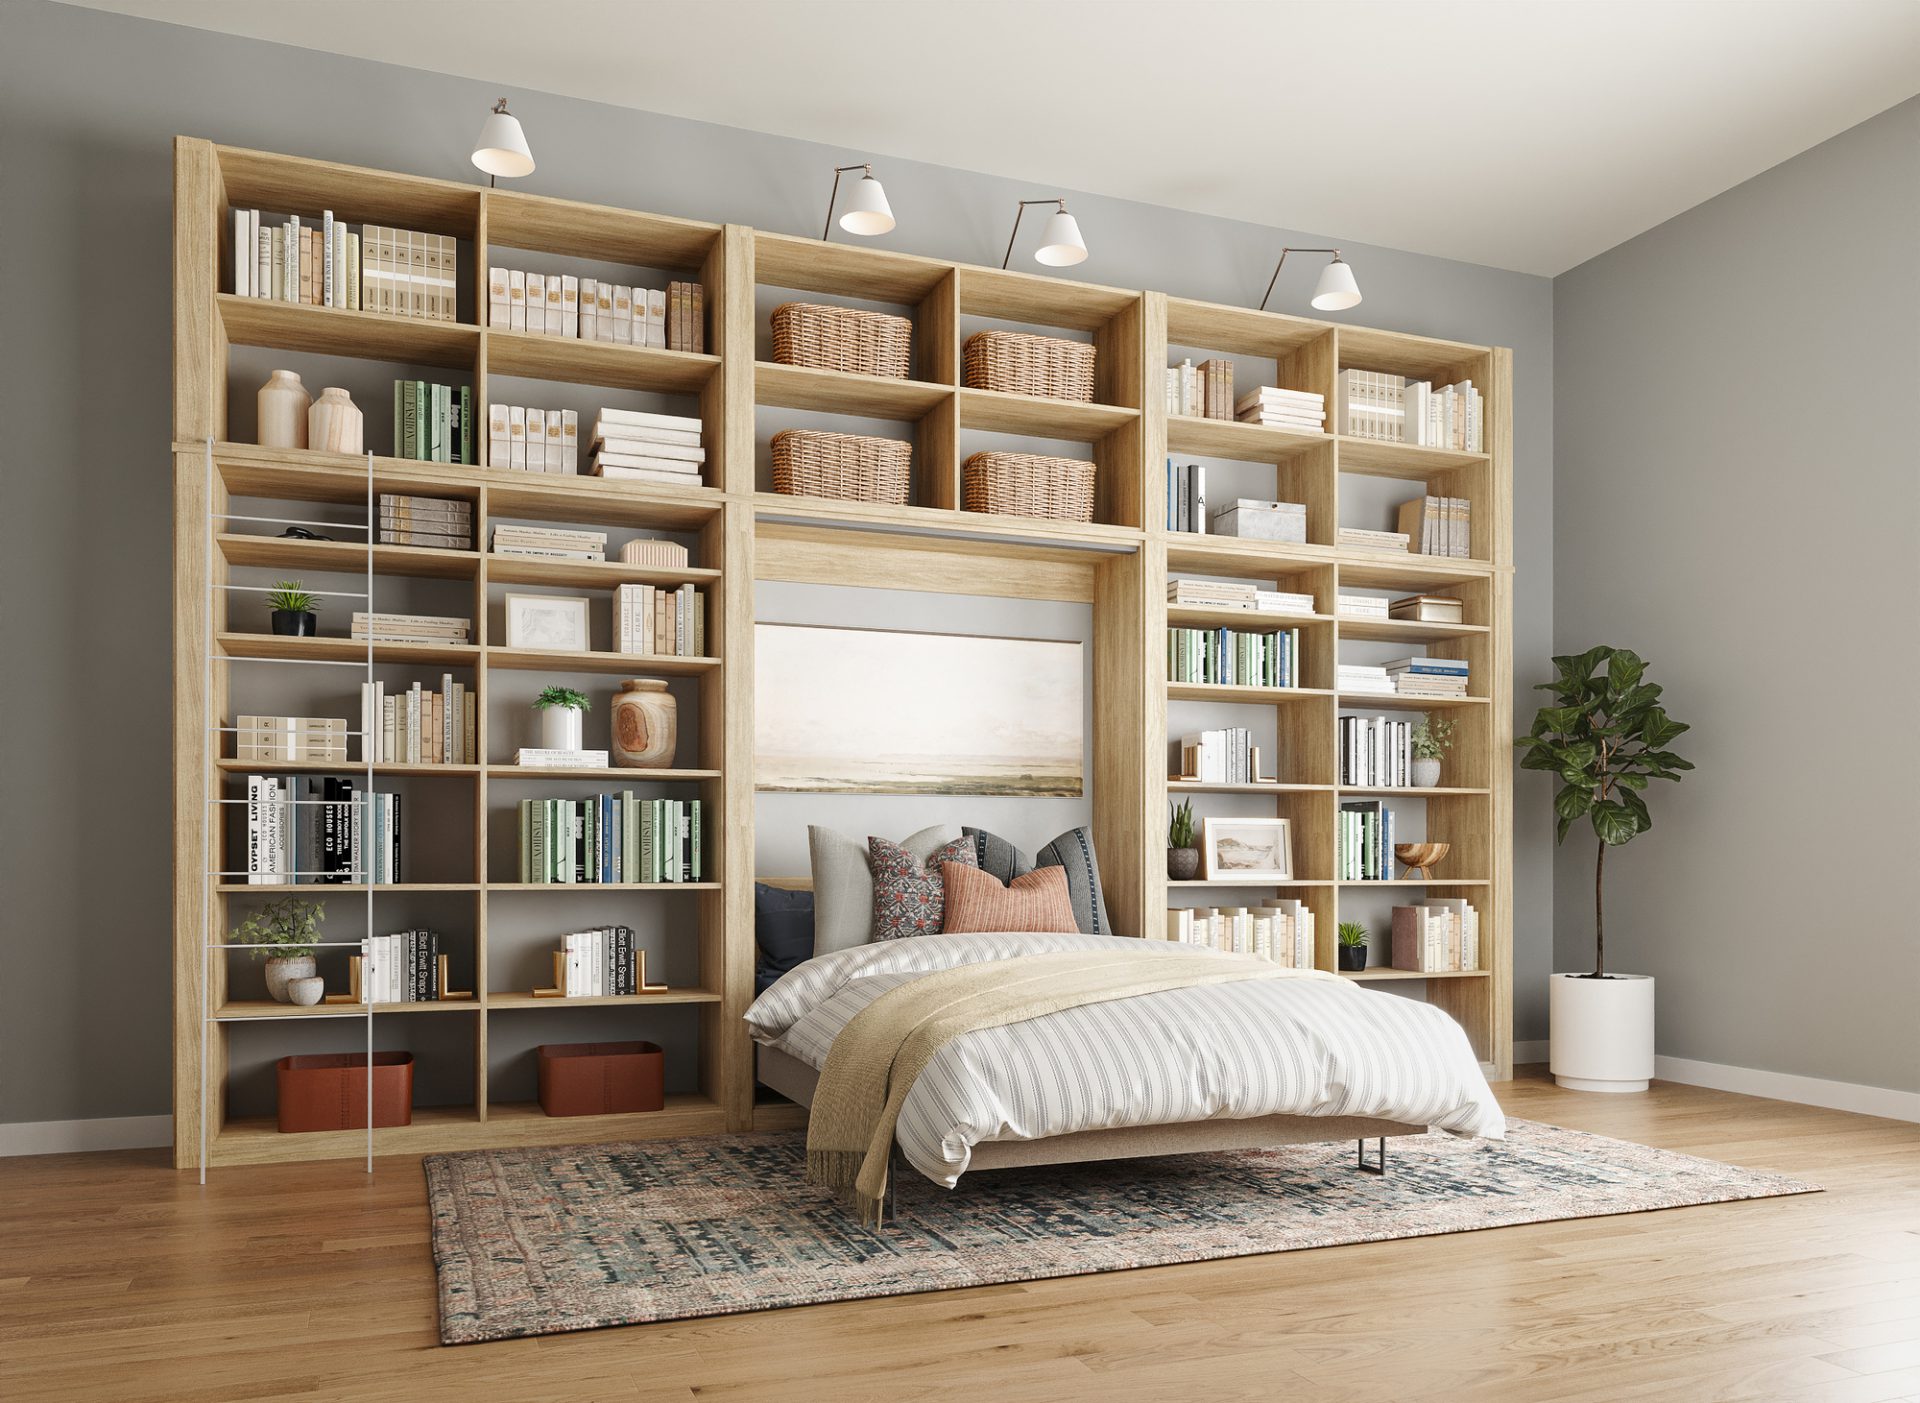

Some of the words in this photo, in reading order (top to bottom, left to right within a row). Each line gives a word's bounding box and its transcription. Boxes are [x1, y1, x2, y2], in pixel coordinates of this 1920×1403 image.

[405, 401, 415, 439] FASHION
[533, 820, 542, 857] FASHION
[643, 820, 652, 856] FASHION
[418, 931, 428, 950] Elliott
[618, 928, 627, 946] Elliott
[418, 951, 428, 970] Erwitt
[618, 947, 627, 965] Erwitt
[417, 971, 428, 994] Snaps
[617, 966, 627, 988] Snaps
